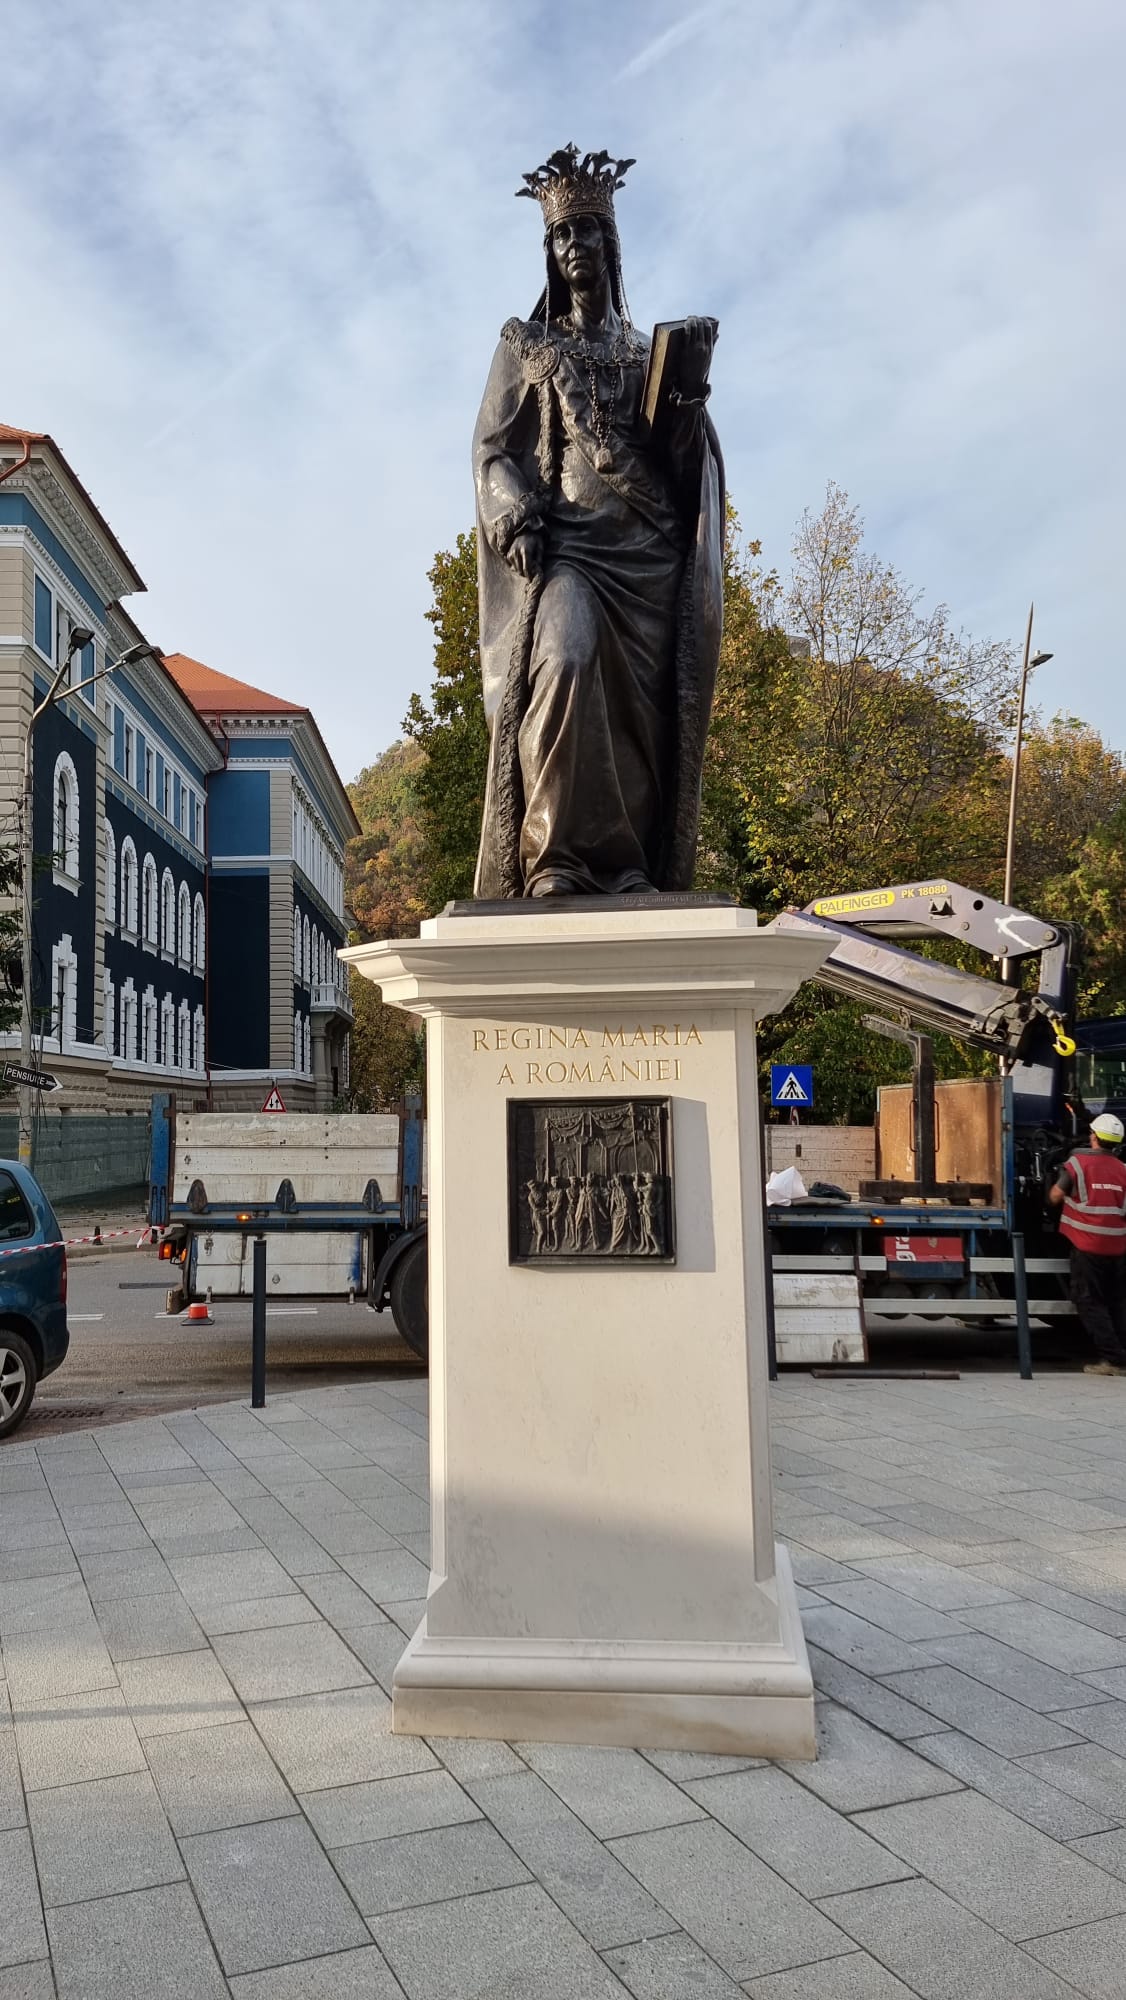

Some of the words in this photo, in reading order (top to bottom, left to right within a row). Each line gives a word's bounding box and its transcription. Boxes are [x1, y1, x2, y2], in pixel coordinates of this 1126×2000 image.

[820, 893, 889, 914] PALFINGER
[901, 889, 915, 899] PK
[918, 885, 947, 897] 18080
[473, 1027, 590, 1051] REGINA
[601, 1024, 703, 1048] MARIA
[497, 1063, 515, 1085] A
[526, 1055, 681, 1084] ROMÂNIEI
